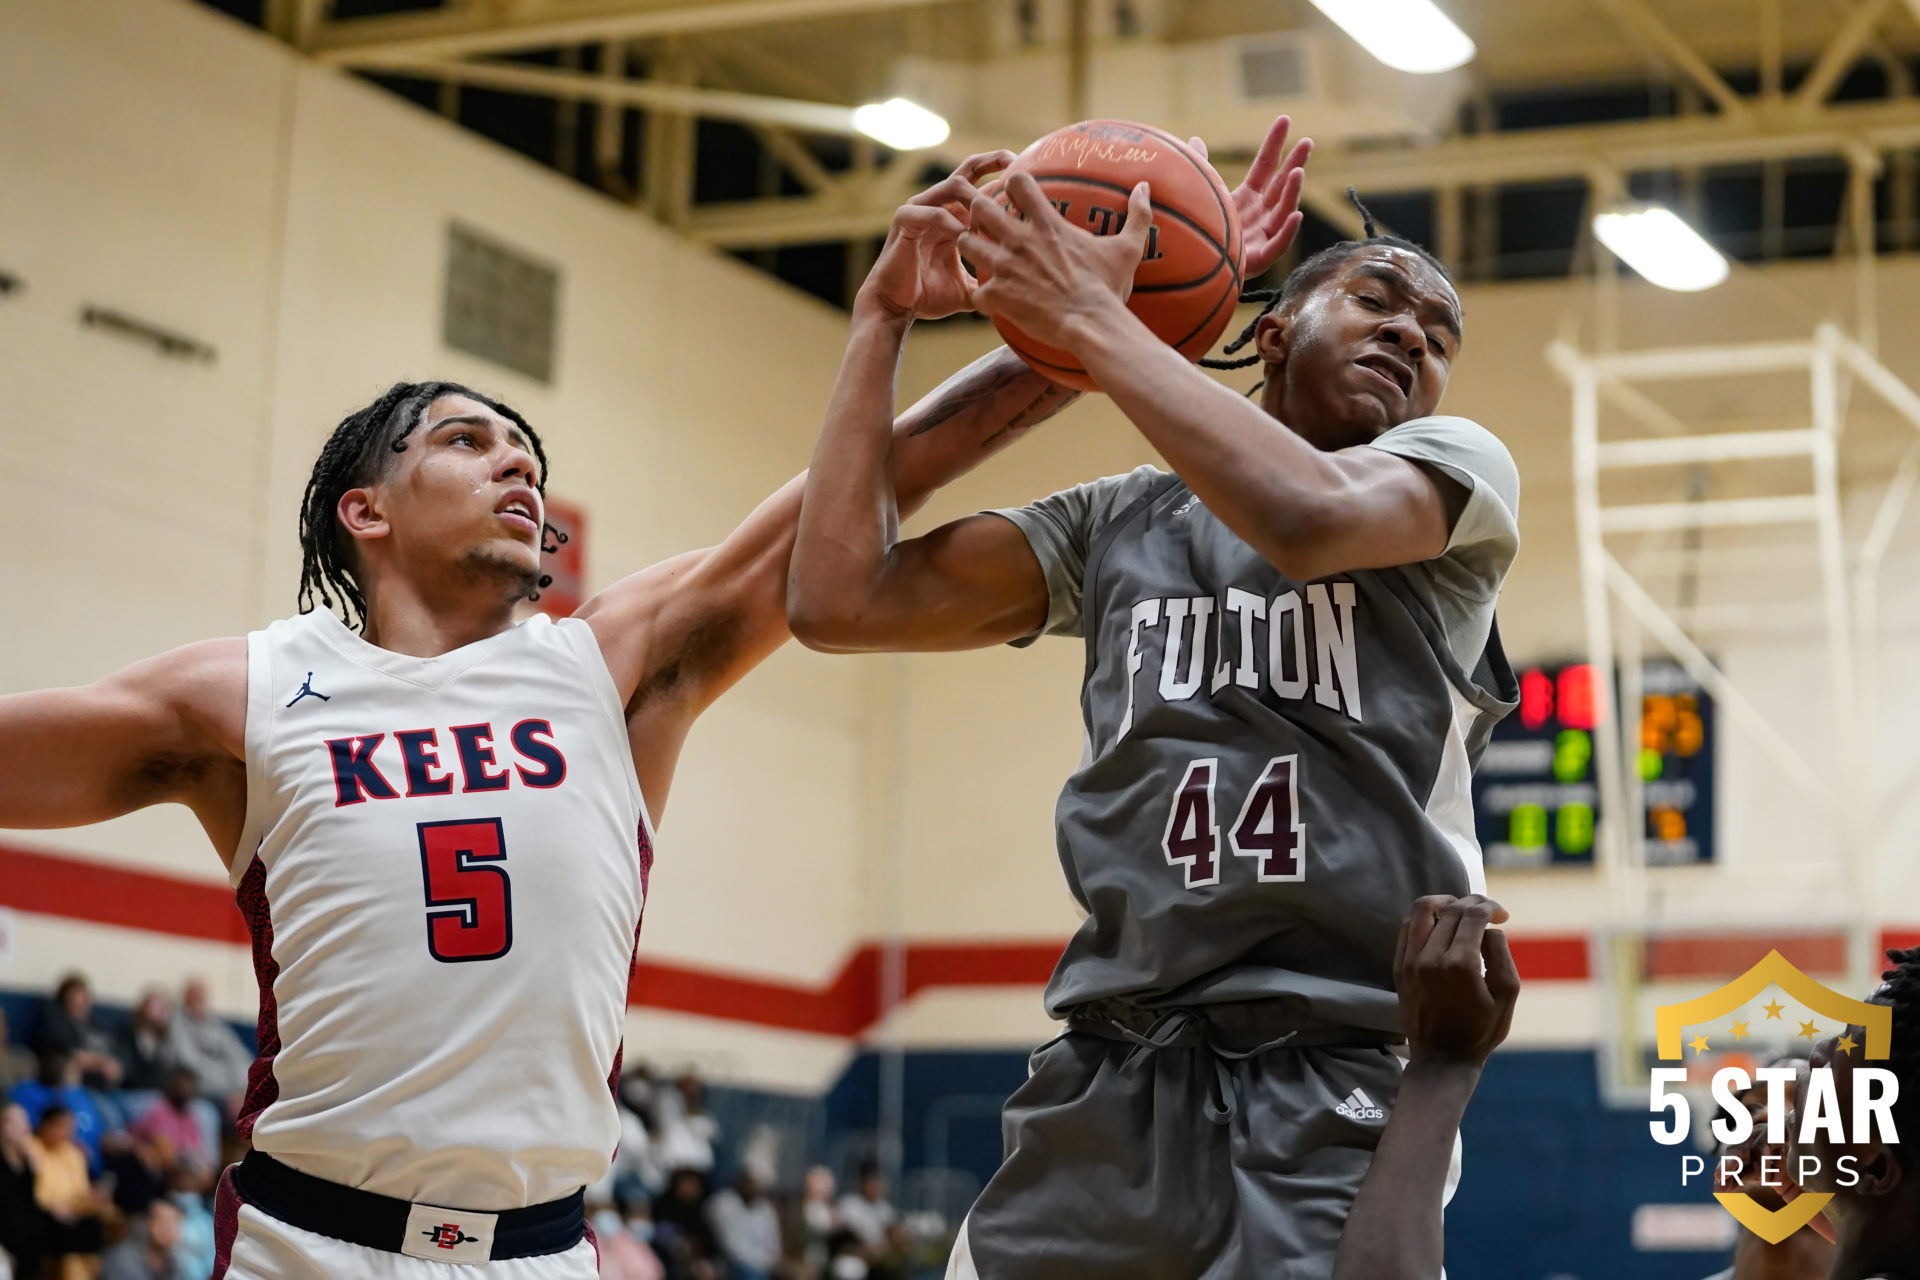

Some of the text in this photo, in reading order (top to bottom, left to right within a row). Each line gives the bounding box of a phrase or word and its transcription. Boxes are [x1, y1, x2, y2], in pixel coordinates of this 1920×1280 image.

[1115, 582, 1363, 746] FULTON
[323, 718, 568, 808] KEES
[1161, 753, 1306, 890] 44
[416, 816, 513, 963] 5
